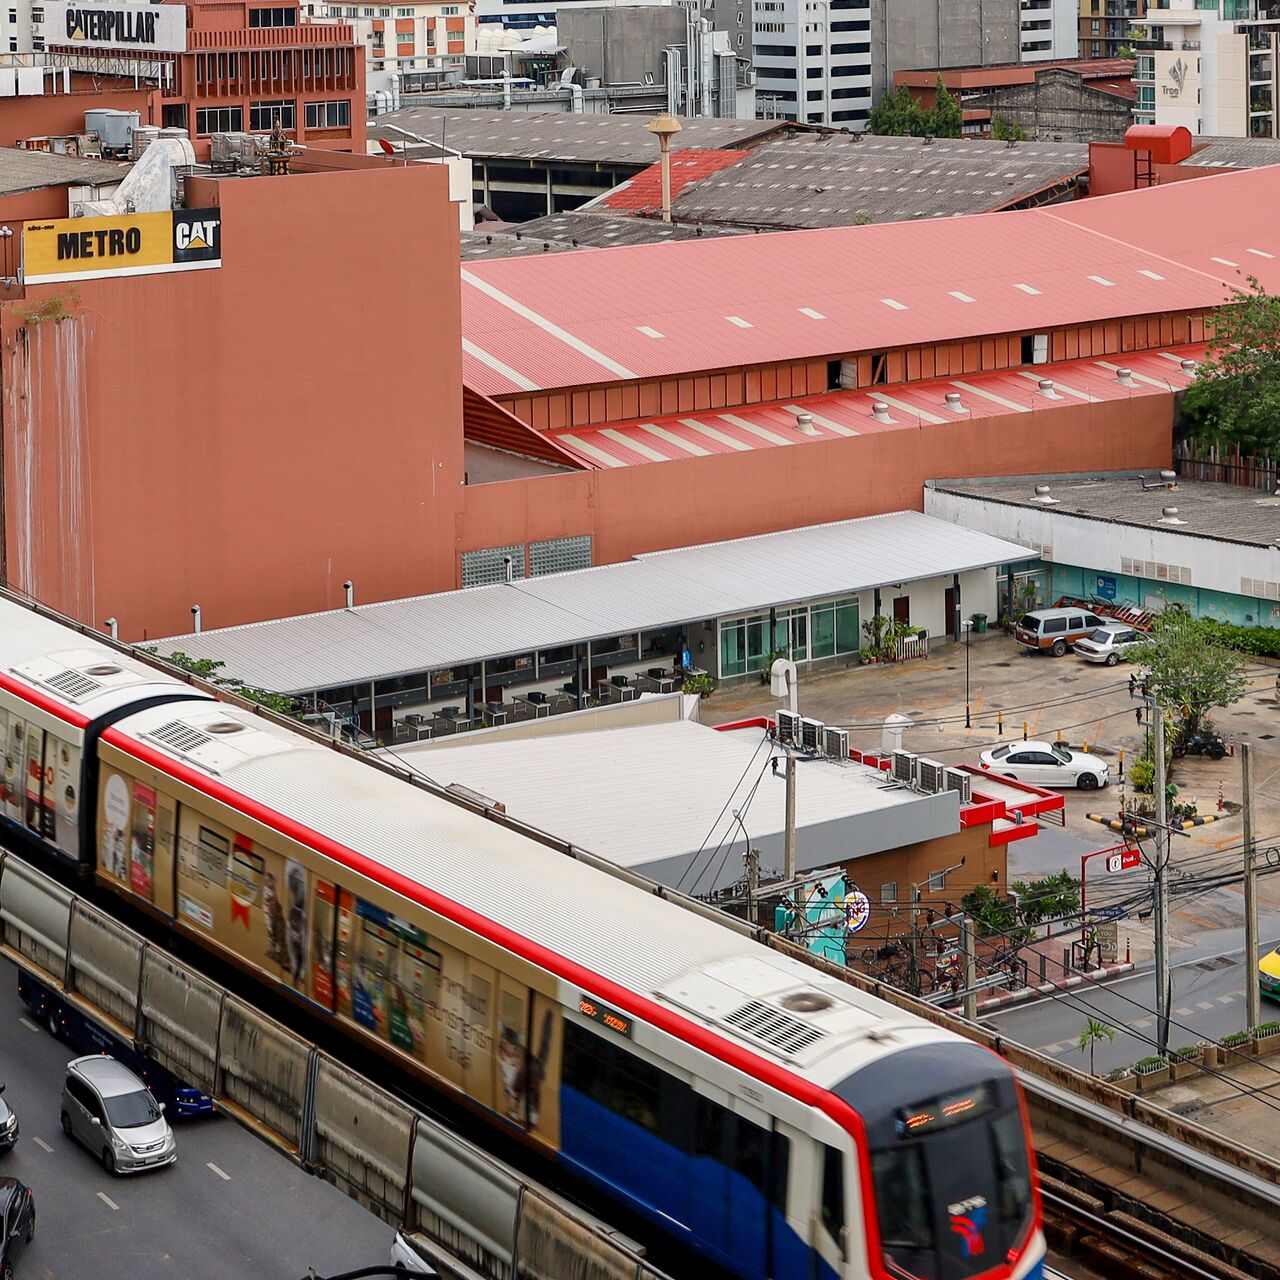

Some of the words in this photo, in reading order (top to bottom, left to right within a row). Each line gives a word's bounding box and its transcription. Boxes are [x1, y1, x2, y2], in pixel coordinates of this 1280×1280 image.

[66, 9, 156, 43] CATERPILLAR
[1161, 85, 1179, 95] Tree
[57, 227, 141, 260] METRO
[176, 220, 217, 250] CAT
